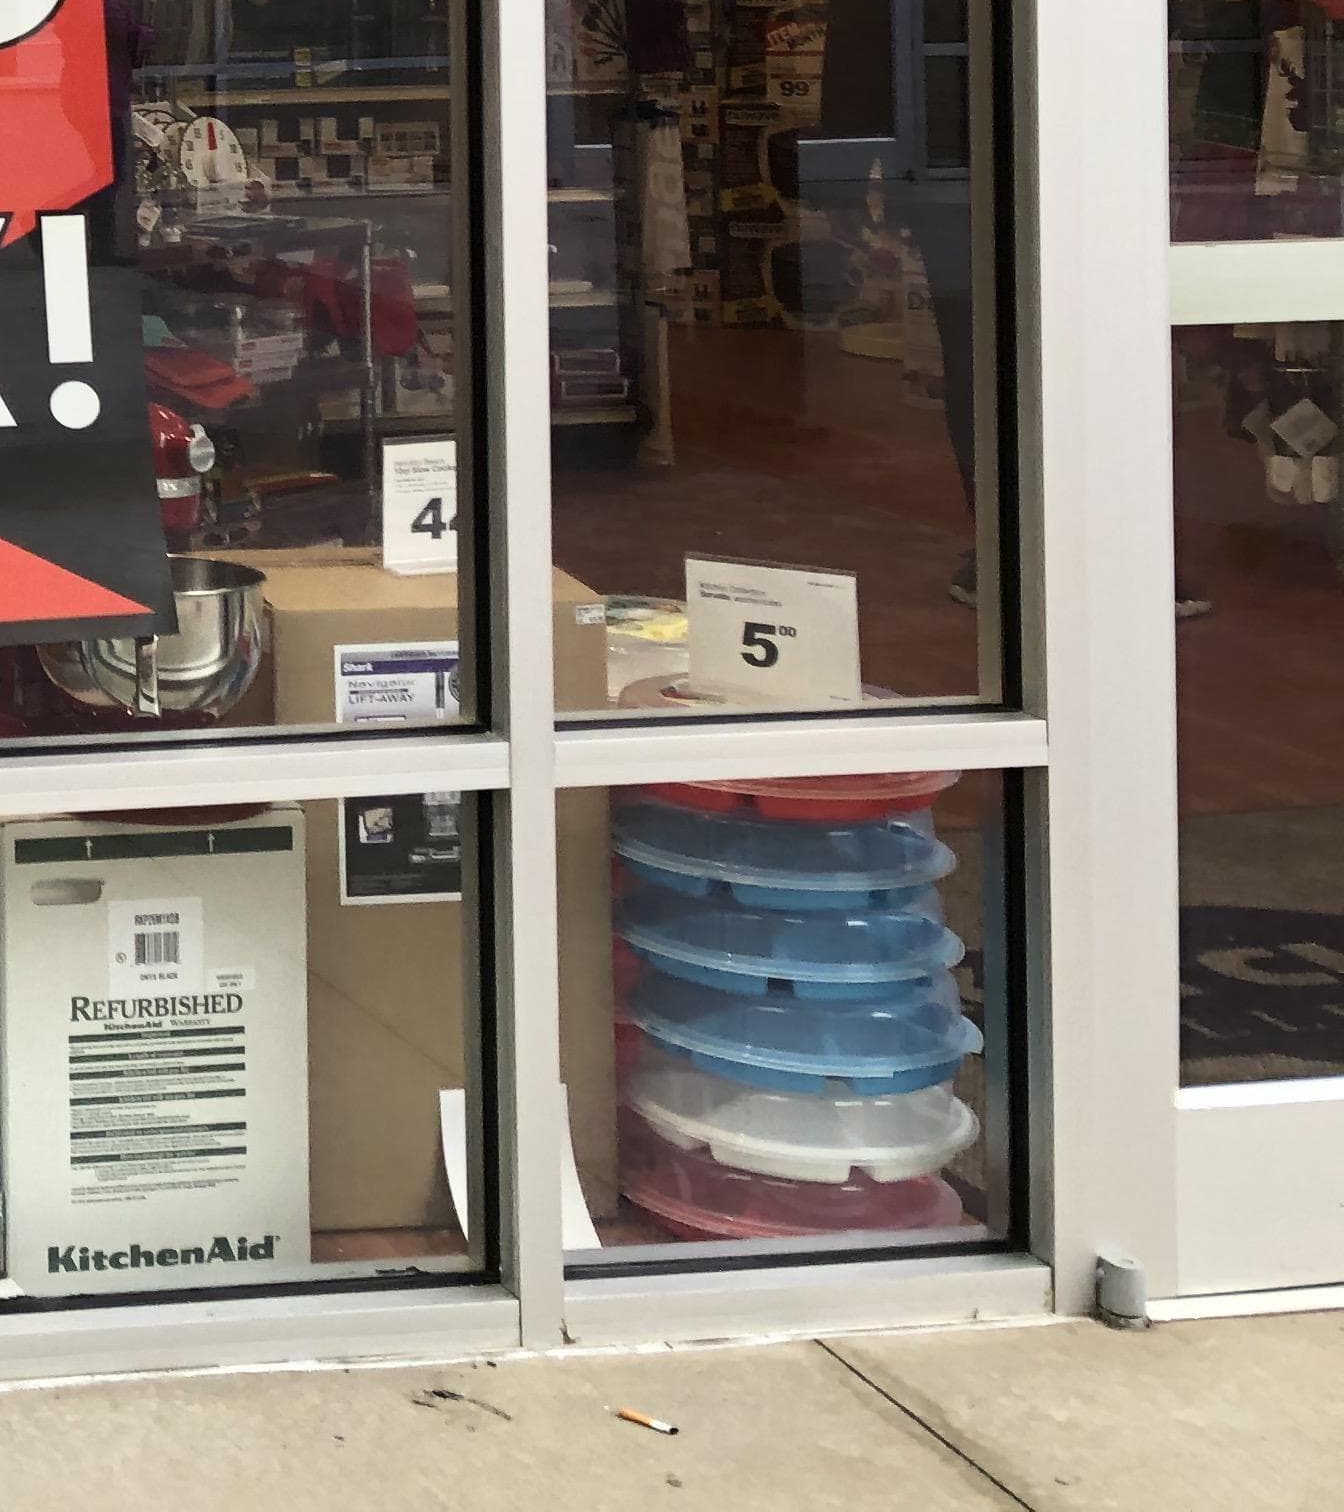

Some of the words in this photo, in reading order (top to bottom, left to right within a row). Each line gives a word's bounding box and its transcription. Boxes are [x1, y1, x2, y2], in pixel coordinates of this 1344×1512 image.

[411, 497, 456, 539] 4
[343, 662, 374, 673] Shark
[69, 992, 244, 1025] REFURBISHED
[104, 1020, 163, 1032] KitchenAid
[47, 1235, 278, 1275] KitchenAid
